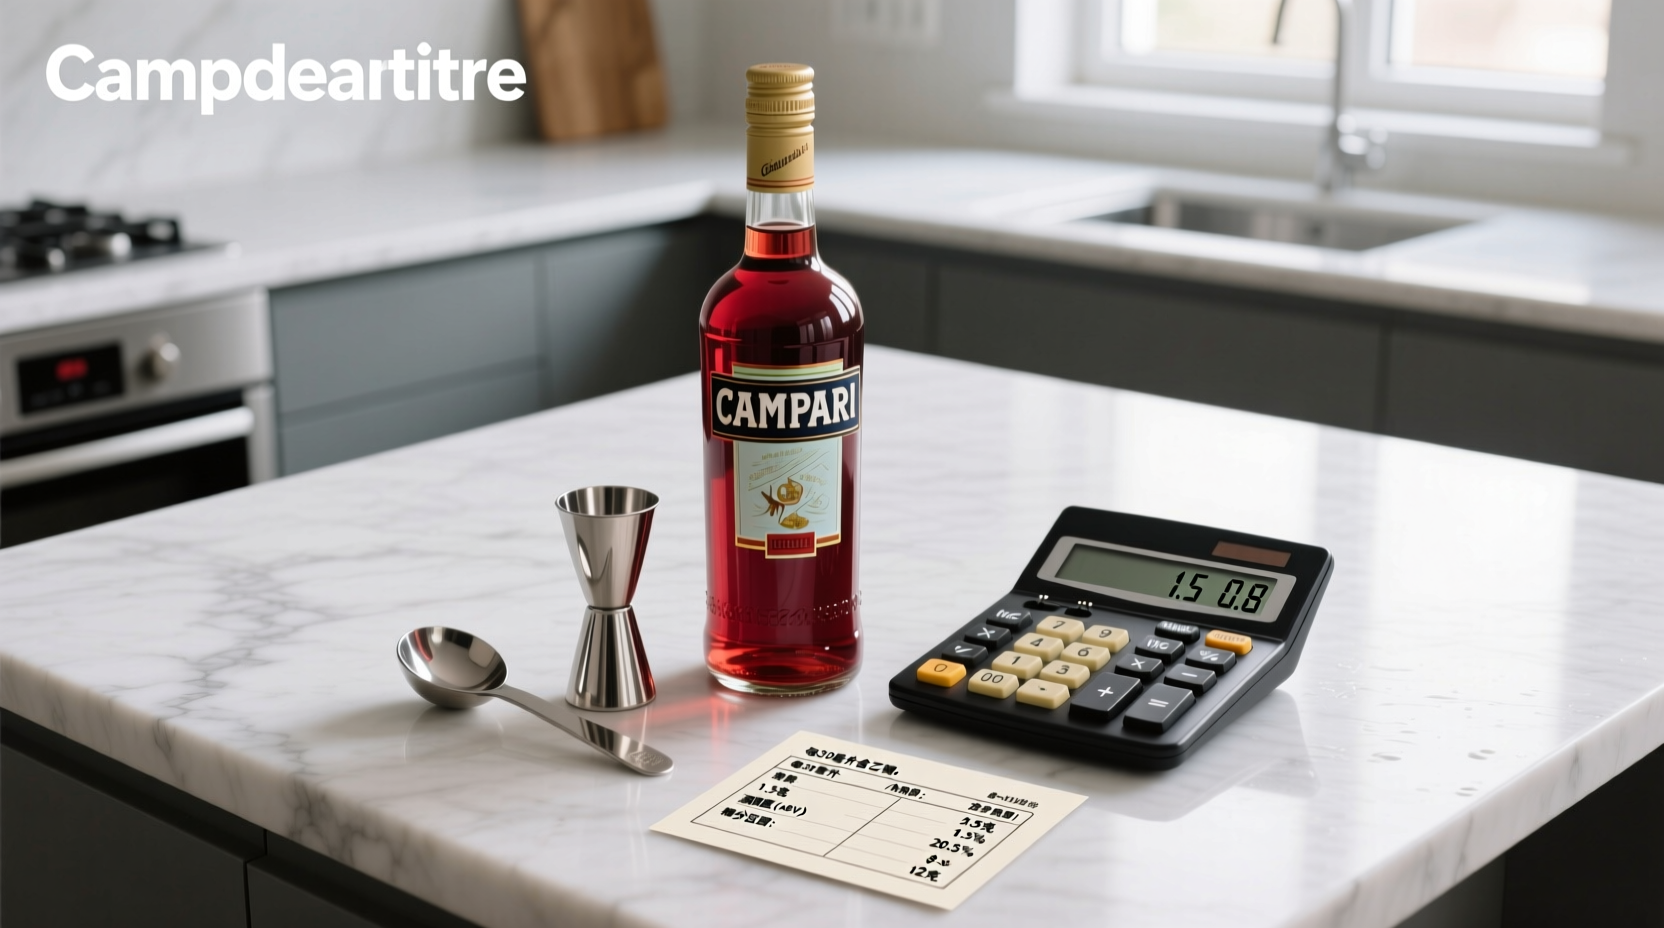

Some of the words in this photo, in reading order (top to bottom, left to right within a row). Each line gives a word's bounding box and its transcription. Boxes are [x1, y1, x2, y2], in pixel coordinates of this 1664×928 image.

[716, 382, 856, 429] CAMPARI
[1168, 571, 1209, 603] 1.5
[1217, 578, 1269, 614] 0.8
[1052, 620, 1066, 630] 7
[1098, 629, 1112, 638] 9
[1030, 638, 1044, 647] 4
[1077, 647, 1093, 657] 6
[1011, 656, 1021, 665] 1
[934, 663, 948, 673] 0
[1056, 665, 1070, 675] 3
[980, 672, 1004, 684] 00
